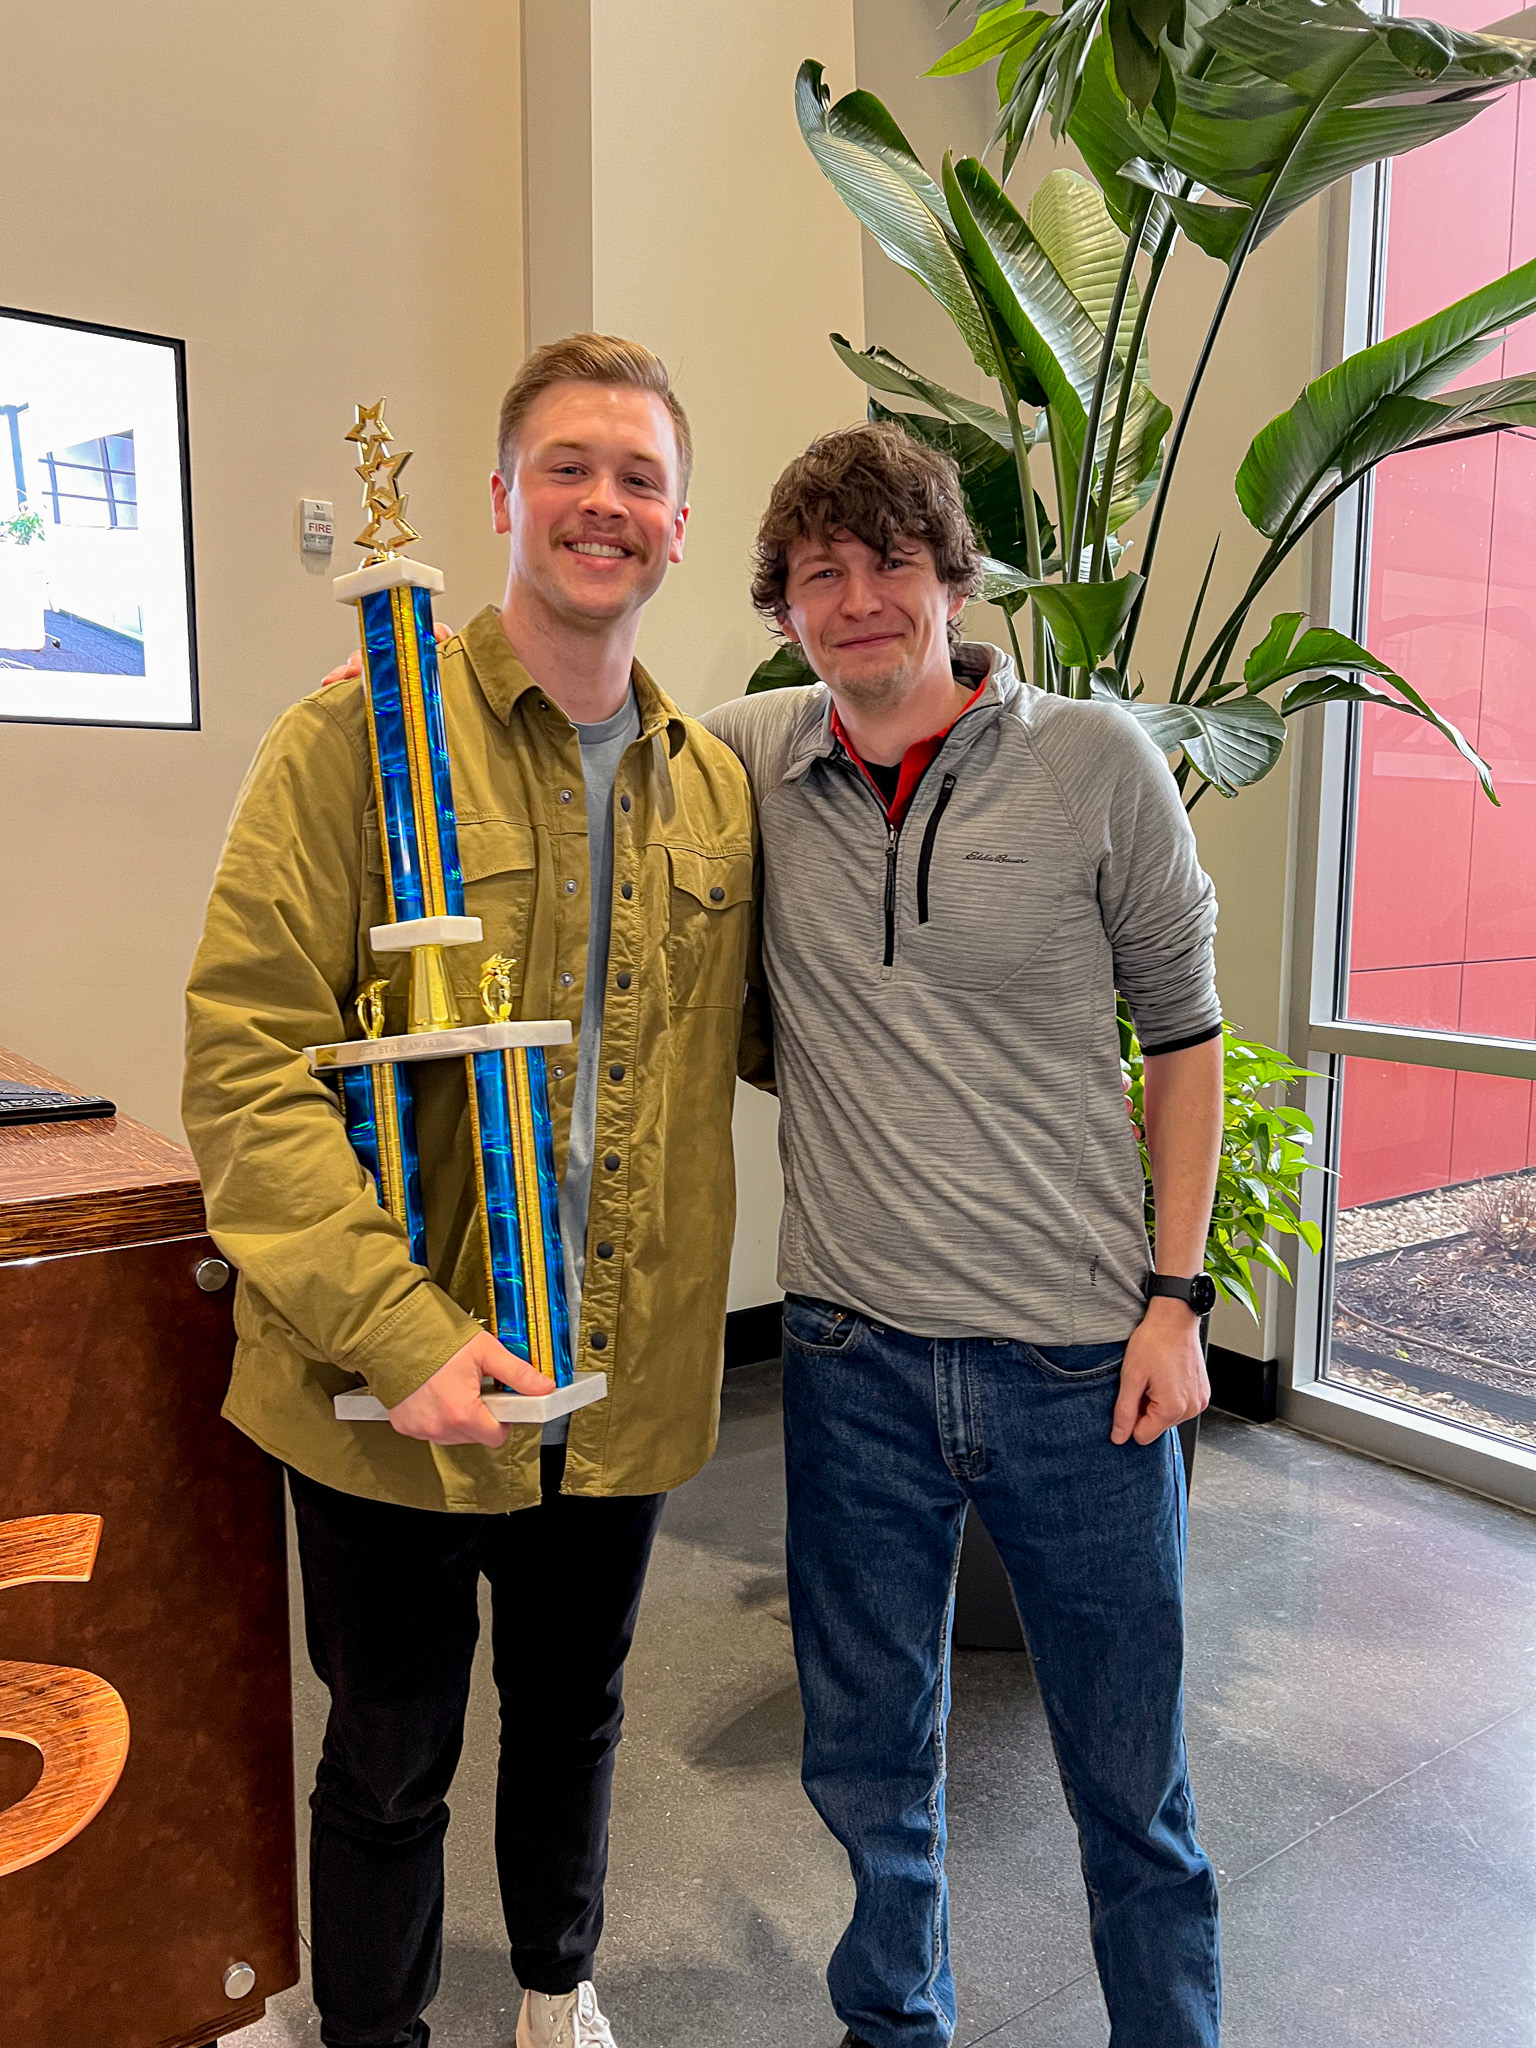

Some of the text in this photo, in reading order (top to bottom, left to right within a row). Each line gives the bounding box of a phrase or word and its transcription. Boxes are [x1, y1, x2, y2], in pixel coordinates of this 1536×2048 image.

[309, 522, 332, 534] FIRE
[963, 851, 1029, 864] Eddie Bauer
[407, 1038, 443, 1051] AWARD
